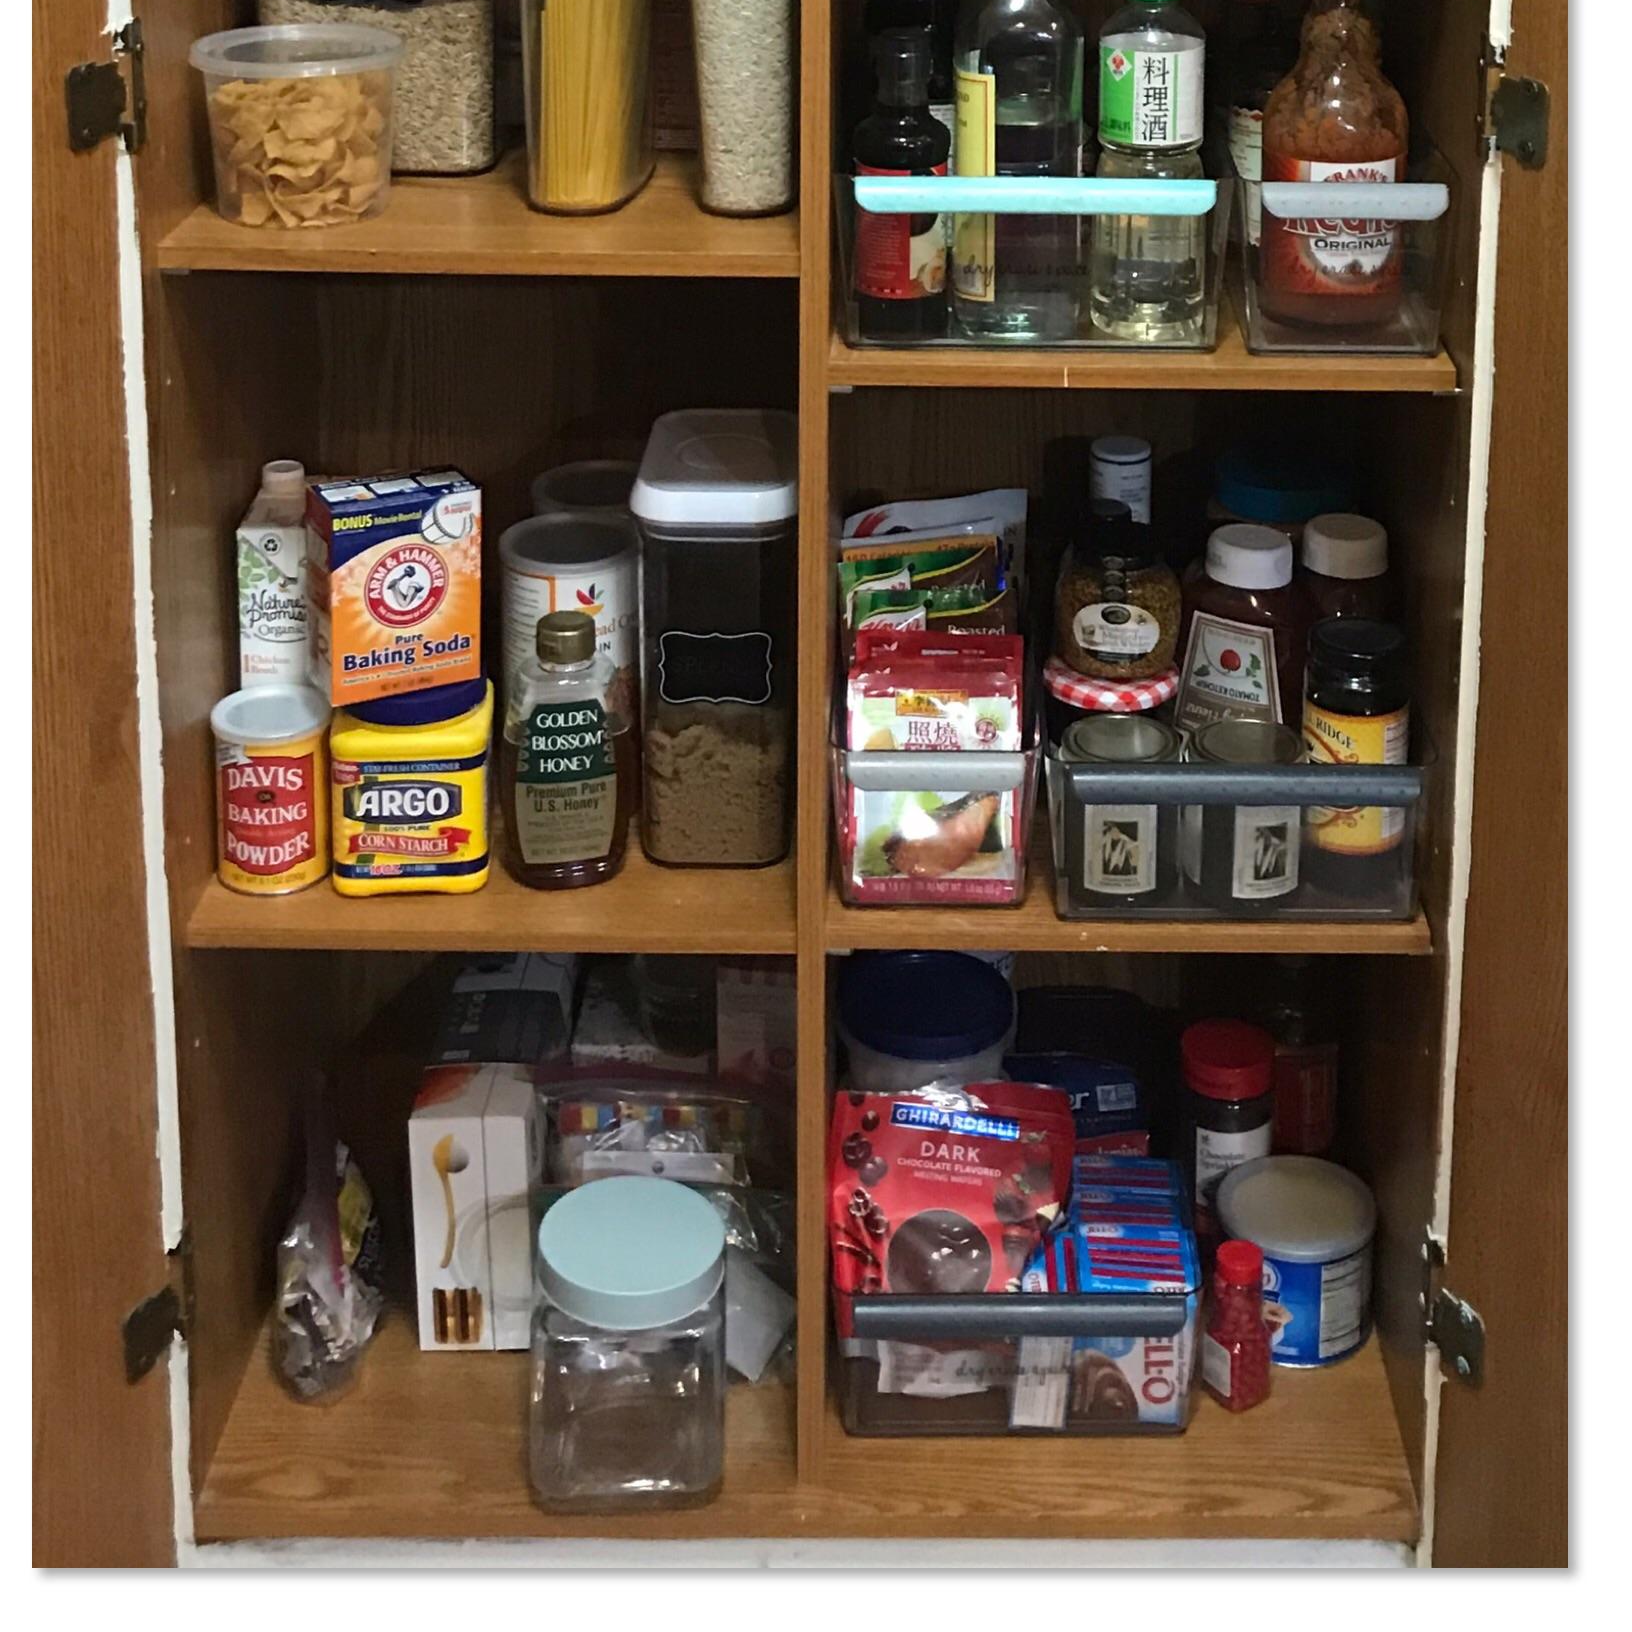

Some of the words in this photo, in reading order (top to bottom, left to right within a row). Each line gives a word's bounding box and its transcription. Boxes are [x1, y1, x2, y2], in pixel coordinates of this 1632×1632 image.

[1141, 56, 1170, 142] 料理酒
[1314, 237, 1392, 250] ORIGINAL
[332, 513, 374, 533] BONUS
[369, 568, 386, 600] ARM
[384, 557, 398, 570] &
[399, 548, 445, 589] HAMMER
[394, 633, 424, 646] Pure
[947, 623, 1006, 636] Roasted
[343, 646, 417, 672] Baking
[423, 633, 471, 657] Soda
[1195, 679, 1229, 698] KETCHUP
[1228, 689, 1262, 703] TOMATO
[536, 709, 599, 729] GOLDEN
[531, 730, 602, 752] BLOSSOM
[907, 720, 960, 745] 照燒
[1315, 716, 1353, 749] RIDGE
[540, 754, 594, 773] HONEY
[228, 766, 304, 791] DAVIS
[526, 784, 578, 799] Premium
[581, 781, 607, 796] Pure
[356, 787, 450, 818] ARGO
[534, 799, 561, 813] U.S.
[564, 797, 600, 811] Honey
[228, 801, 308, 826] BAKING
[227, 831, 311, 866] POWDER
[357, 834, 395, 848] CORN
[399, 836, 449, 853] STARCH
[895, 1106, 1021, 1140] GHIRARDELLI
[920, 1140, 981, 1163] DARK
[896, 1156, 952, 1172] CHOCOLATE
[954, 1161, 1002, 1177] FLAVORED
